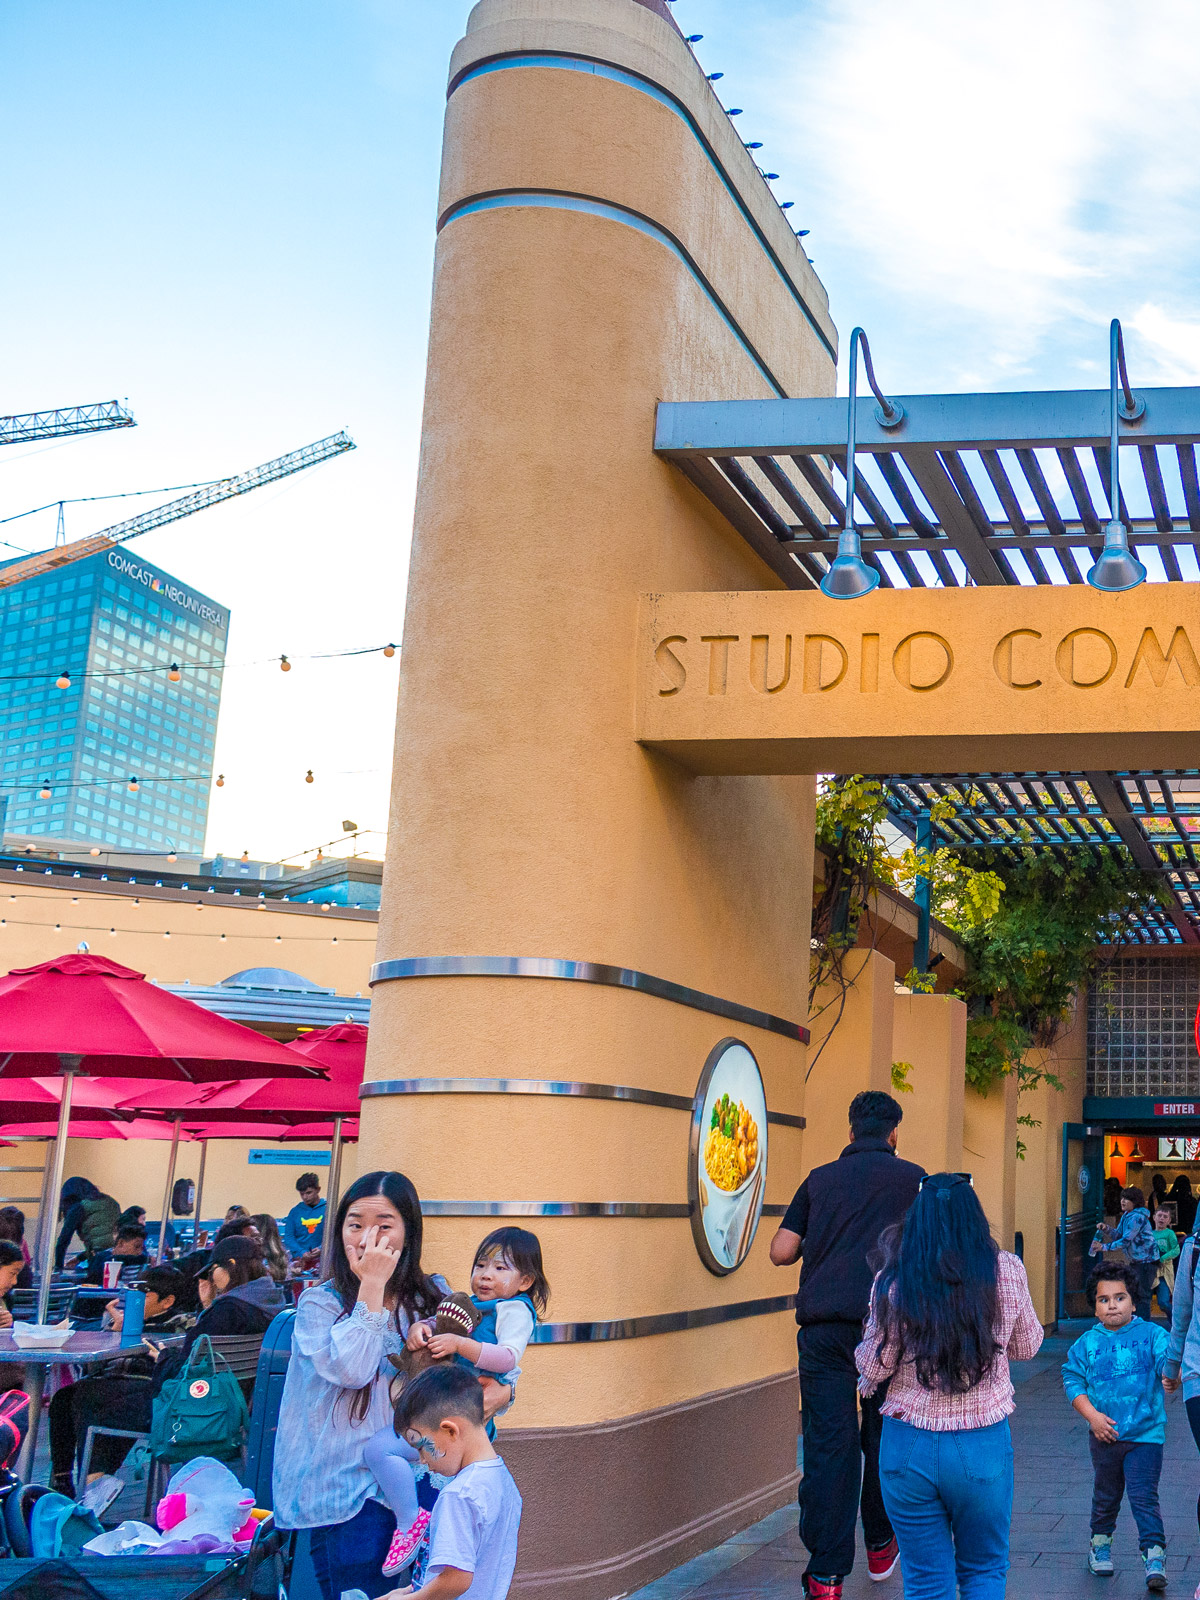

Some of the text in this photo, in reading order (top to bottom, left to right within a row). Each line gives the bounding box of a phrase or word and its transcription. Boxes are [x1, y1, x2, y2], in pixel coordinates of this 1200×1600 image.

[108, 552, 225, 630] COMCAST NBCUNIVERSAL
[653, 629, 955, 698] STUDIO
[1162, 1103, 1195, 1115] ENTER
[1087, 1337, 1149, 1360] FRIENDS
